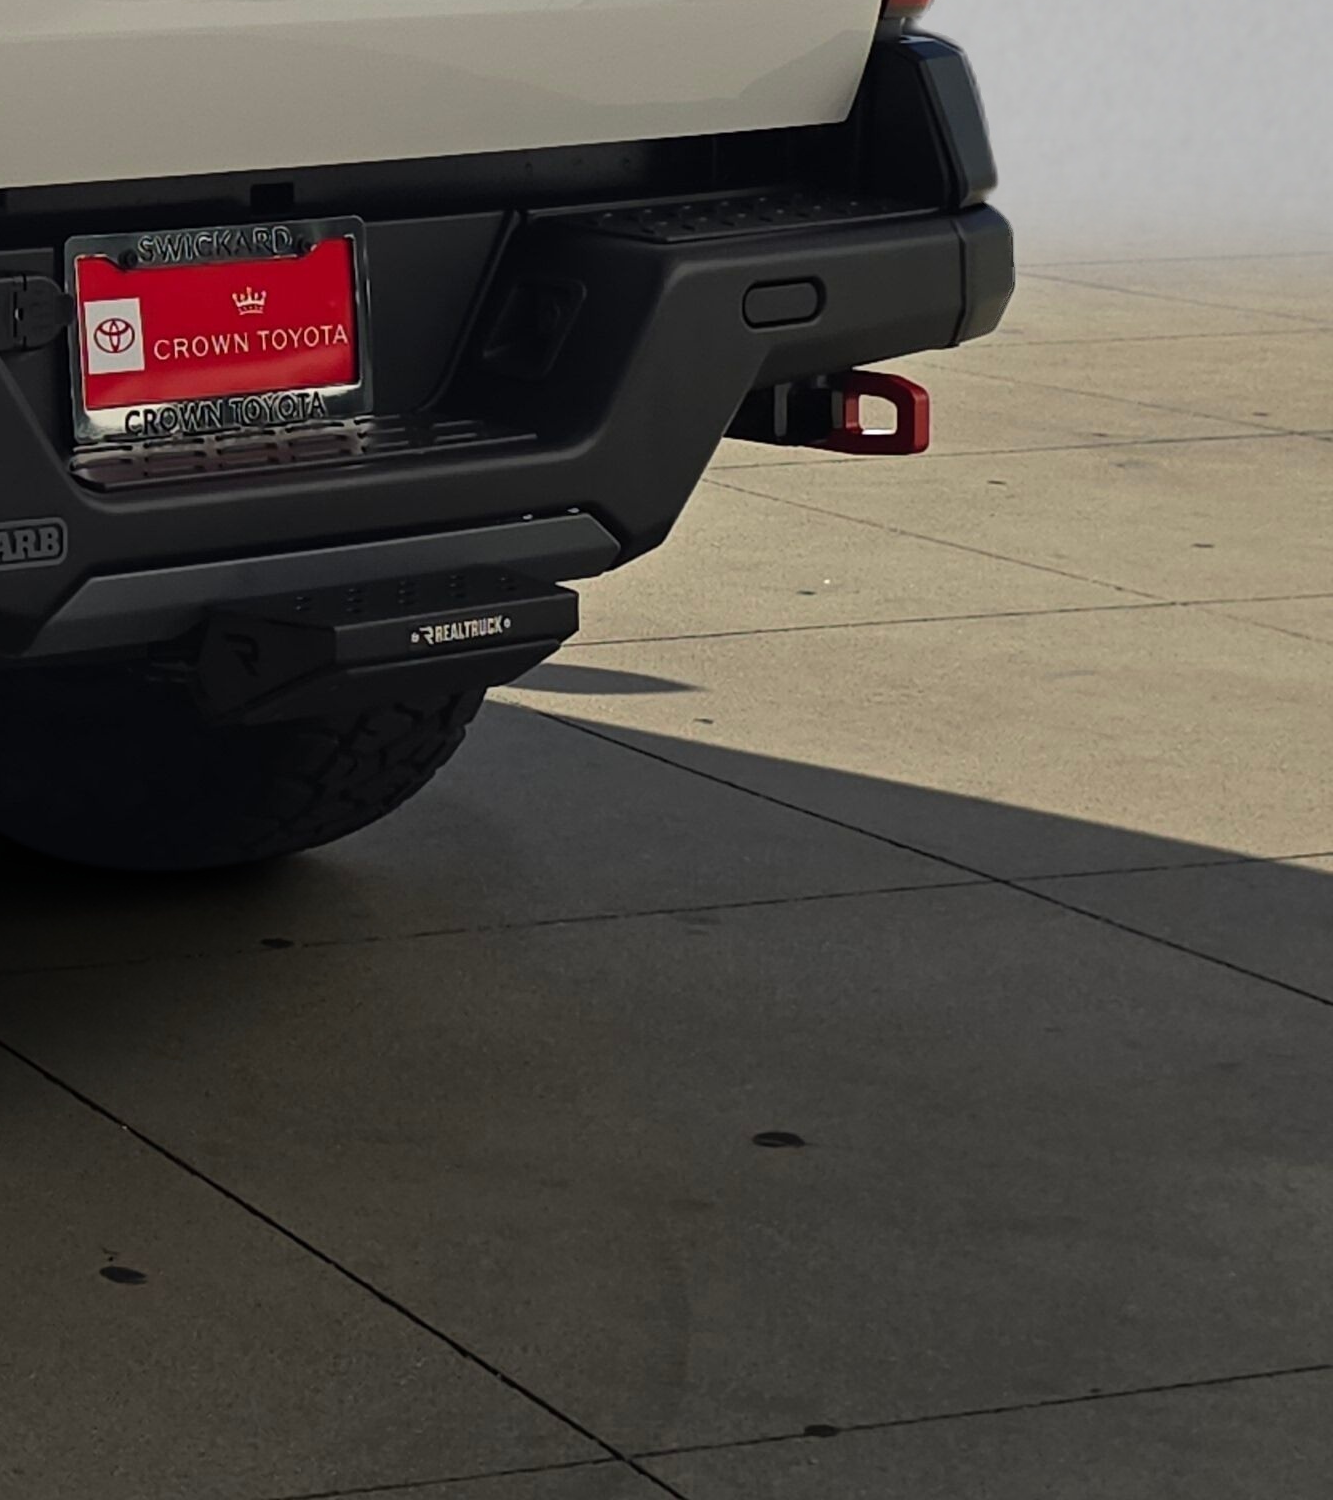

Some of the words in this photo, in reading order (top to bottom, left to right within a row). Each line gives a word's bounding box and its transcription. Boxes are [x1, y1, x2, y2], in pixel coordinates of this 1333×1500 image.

[136, 226, 293, 263] SWICKARD
[153, 332, 250, 361] CROWN
[256, 323, 349, 352] TOYOTA
[124, 397, 225, 436] CROWN
[229, 390, 327, 426] TOYOTA
[434, 615, 503, 643] REALTRUCK
